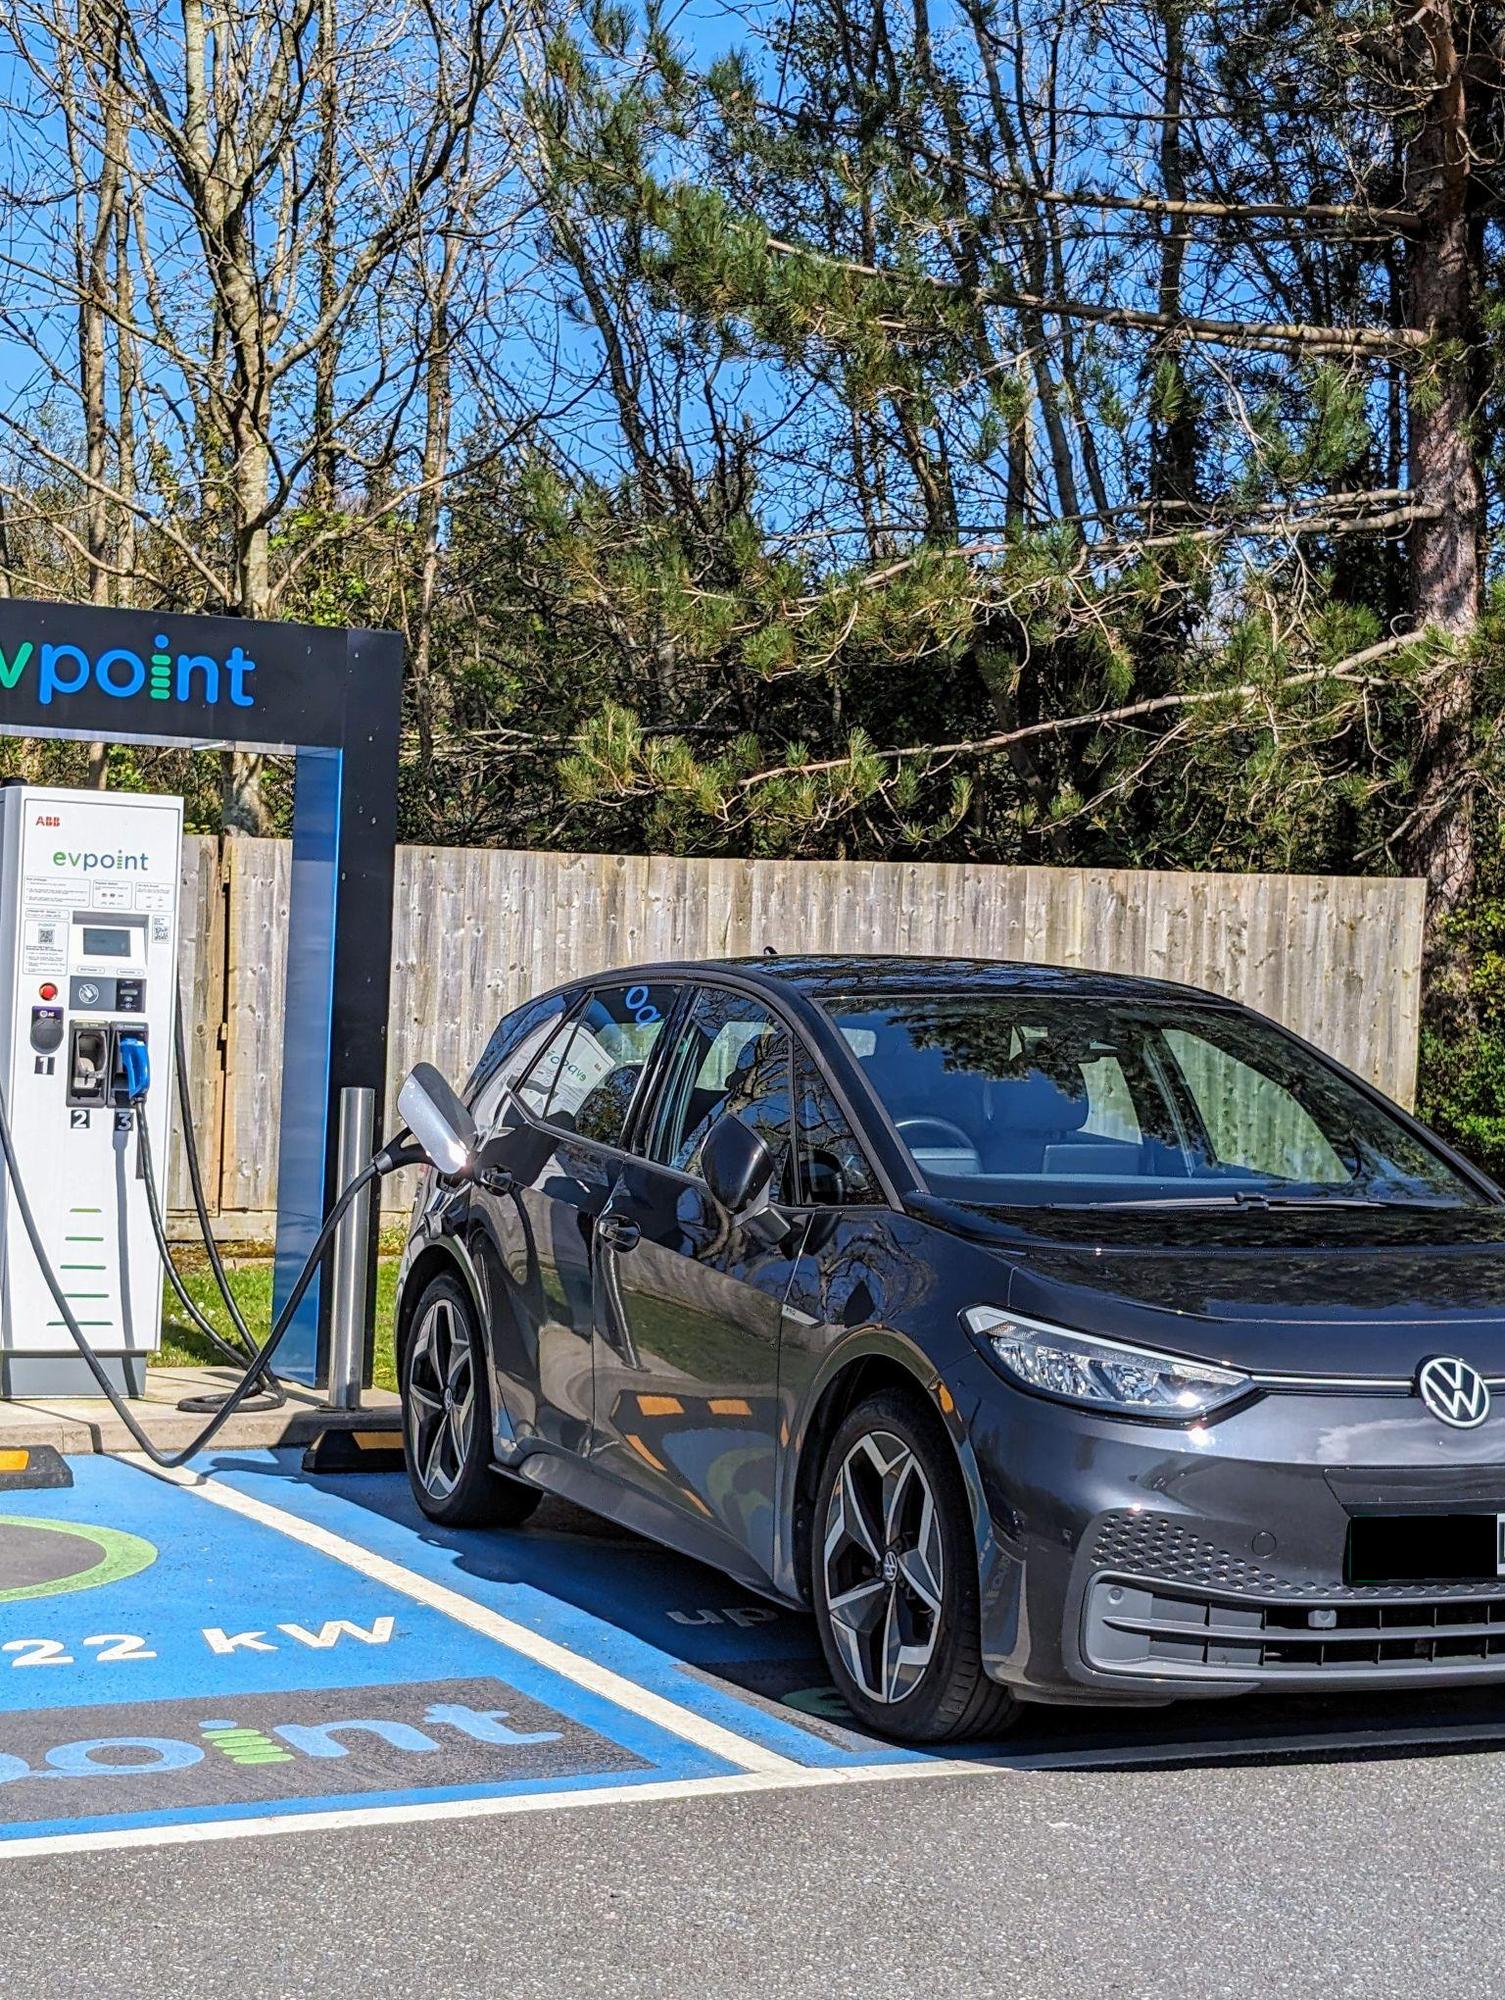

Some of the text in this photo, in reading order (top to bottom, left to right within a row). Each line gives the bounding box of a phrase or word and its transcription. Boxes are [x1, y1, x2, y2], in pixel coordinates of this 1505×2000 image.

[35, 815, 61, 827] ABB
[53, 850, 148, 871] evpoint
[39, 1057, 49, 1074] 1
[73, 1111, 87, 1128] 2
[118, 1113, 132, 1130] 3
[1421, 1358, 1490, 1428] VW
[667, 1607, 779, 1628] up
[2, 1616, 396, 1667] 22 kW
